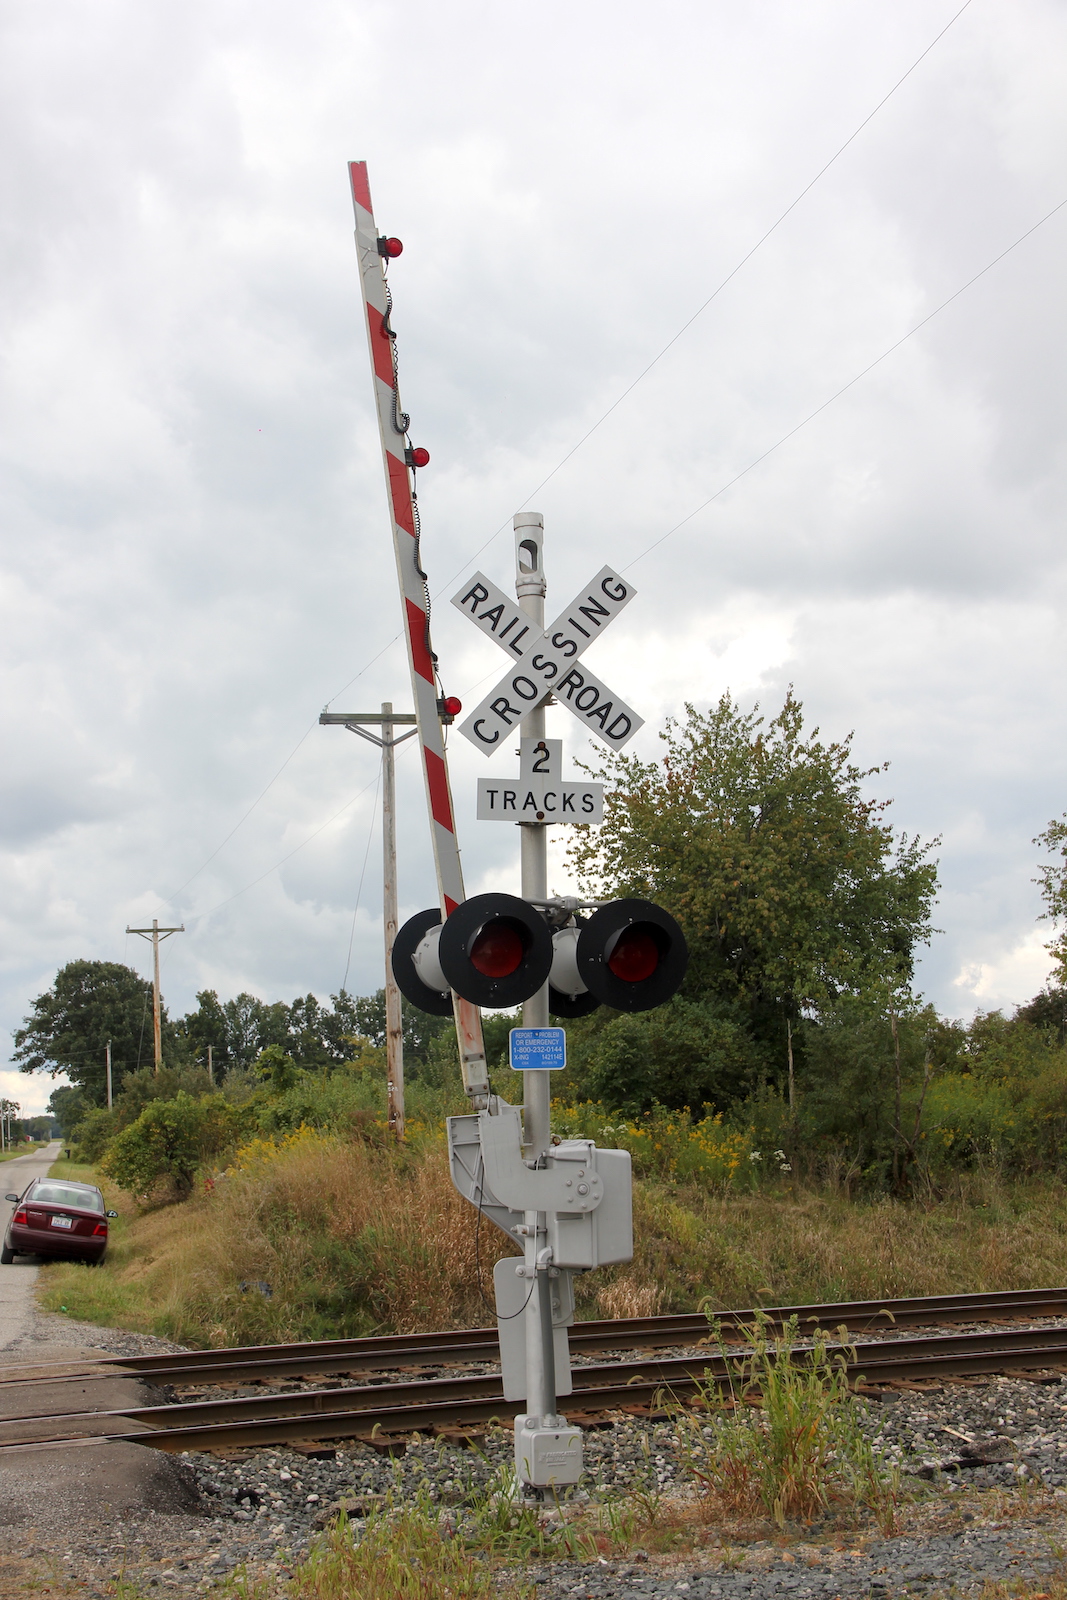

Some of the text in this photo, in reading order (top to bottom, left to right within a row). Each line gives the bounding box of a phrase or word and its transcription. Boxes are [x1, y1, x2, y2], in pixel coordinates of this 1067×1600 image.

[461, 582, 631, 740] RAIL ROAD
[473, 577, 627, 743] CROSSING
[486, 790, 594, 813] TRACKS
[532, 746, 550, 774] 2
